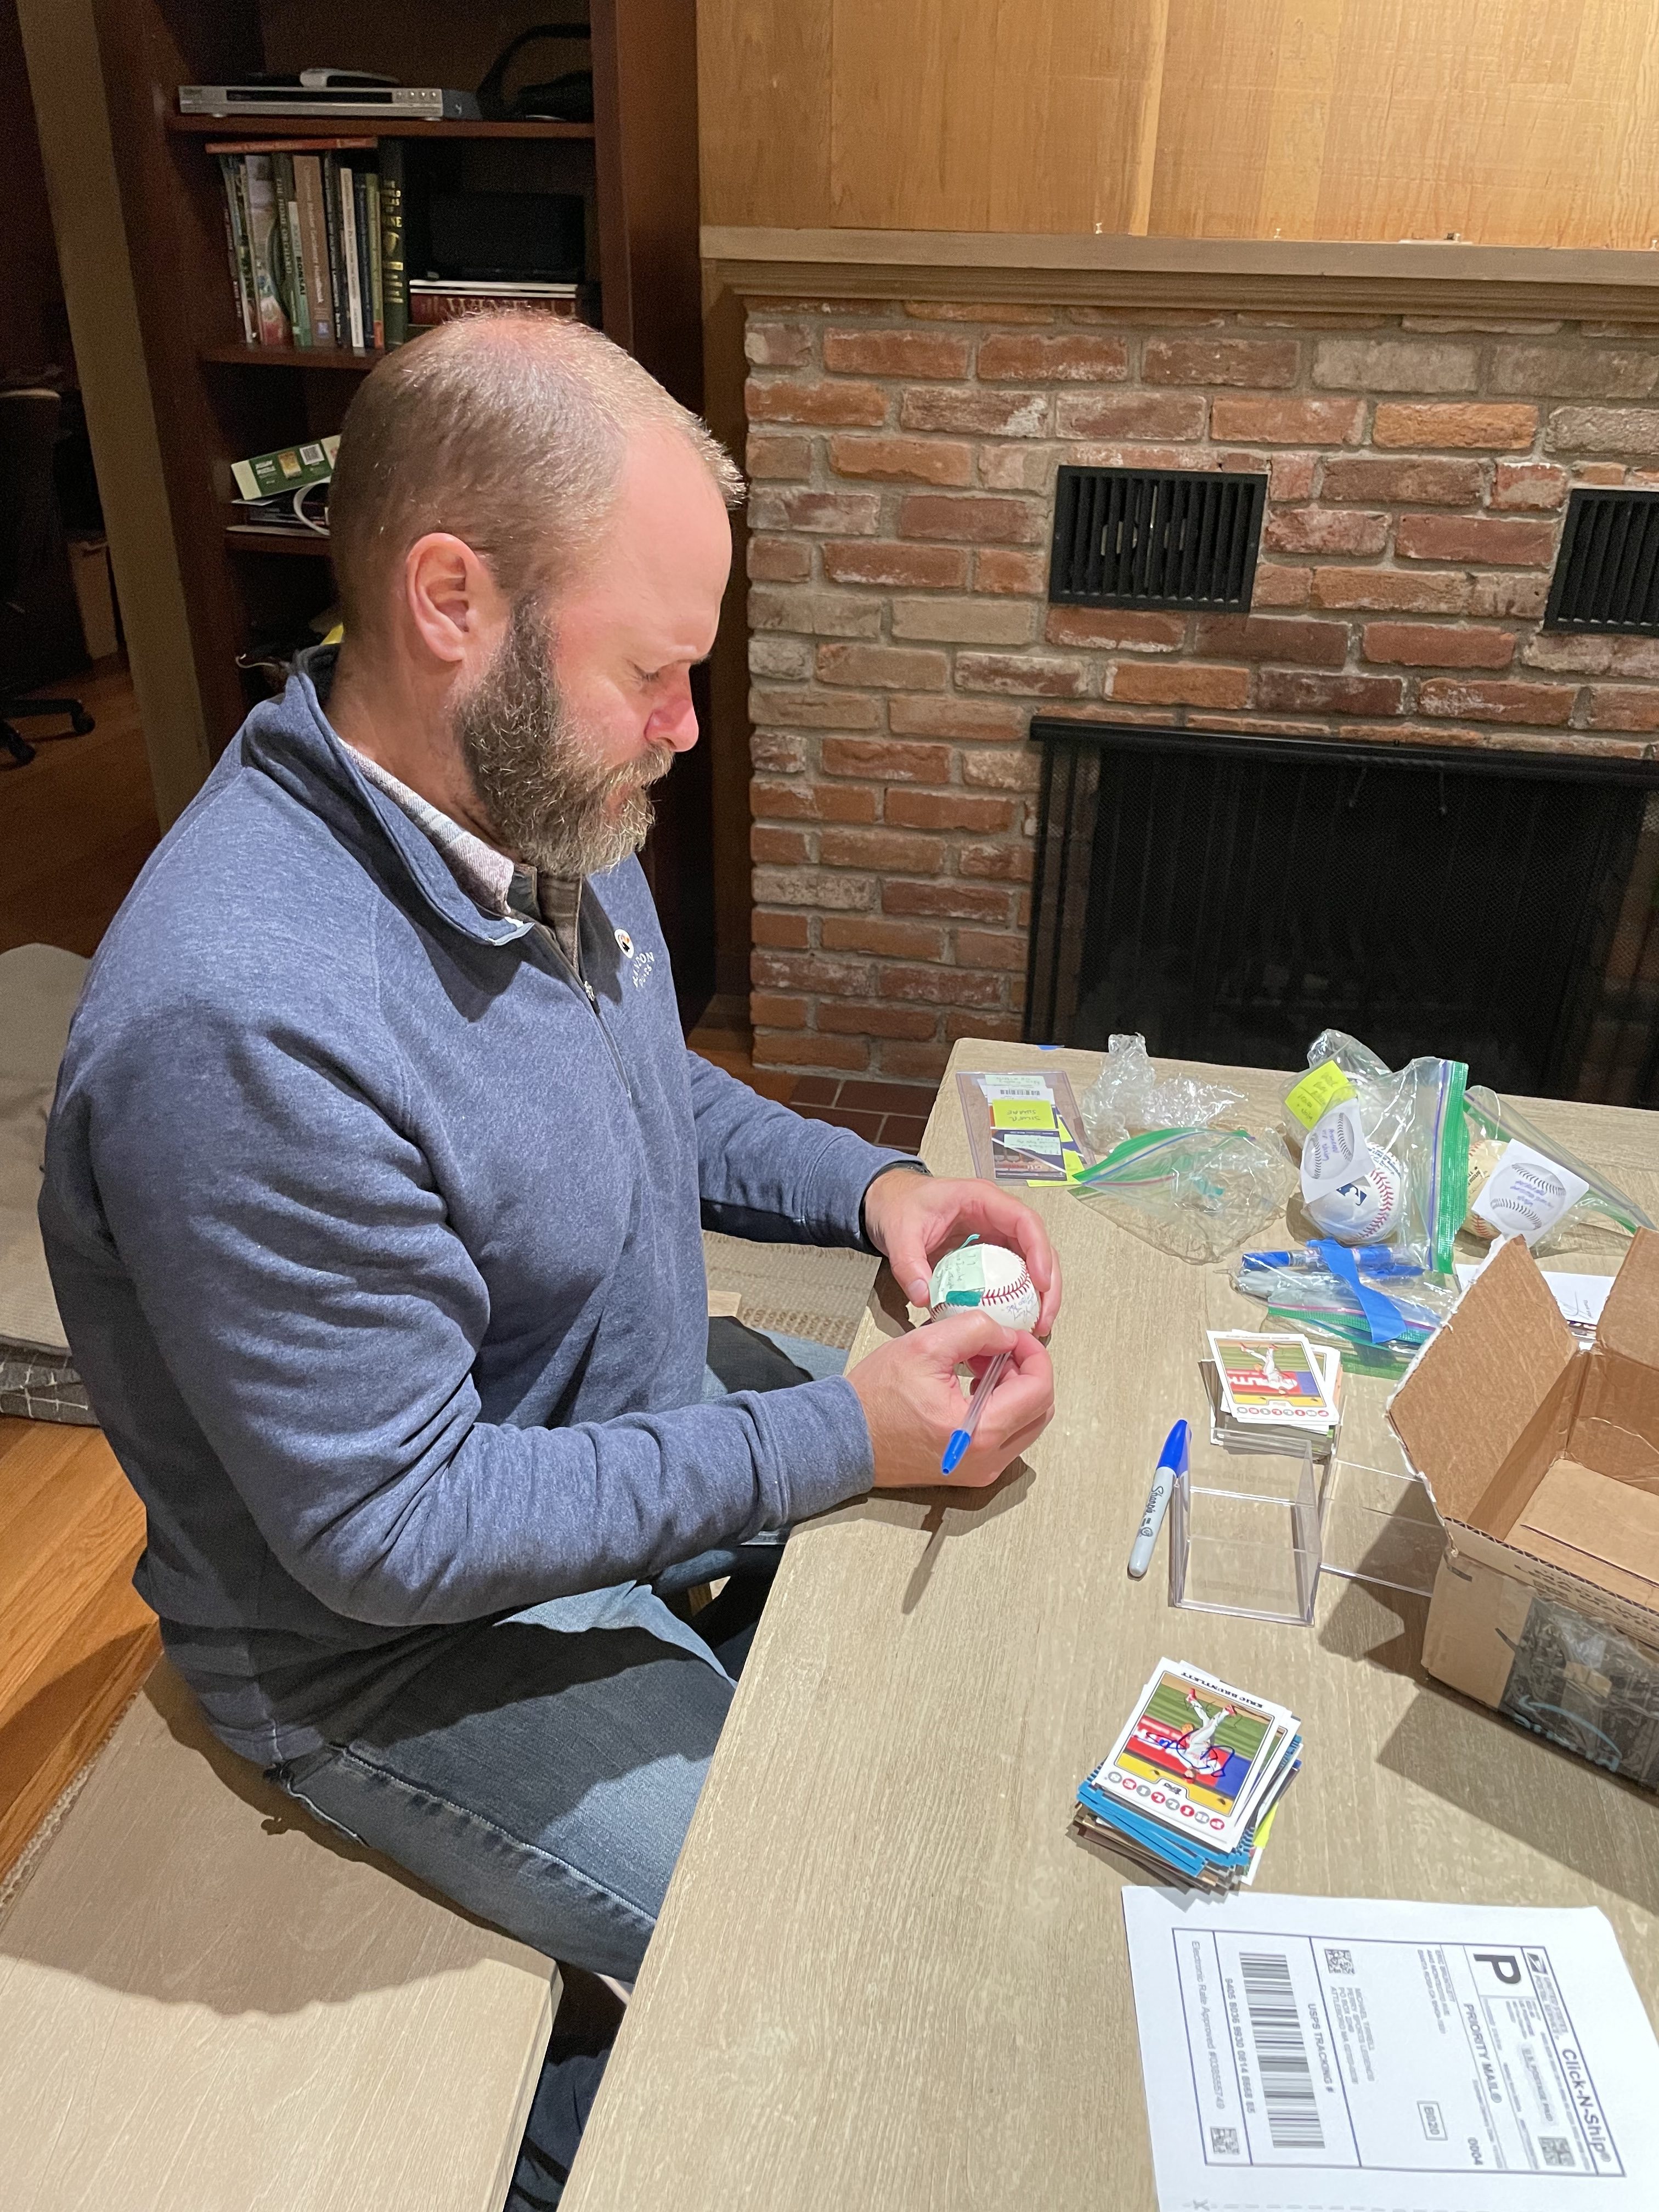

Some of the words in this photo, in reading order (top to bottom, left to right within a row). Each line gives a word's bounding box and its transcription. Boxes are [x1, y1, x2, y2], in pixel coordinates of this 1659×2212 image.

[1239, 1696, 1263, 1708] ERIC
[1191, 1940, 1206, 1982] Electronic
[1473, 1954, 1521, 1984] P
[1198, 1984, 1210, 2005] Rate
[1199, 2006, 1216, 2049] Approved
[1307, 2004, 1321, 2029] USPS
[1462, 2003, 1491, 2060] PRIORITY
